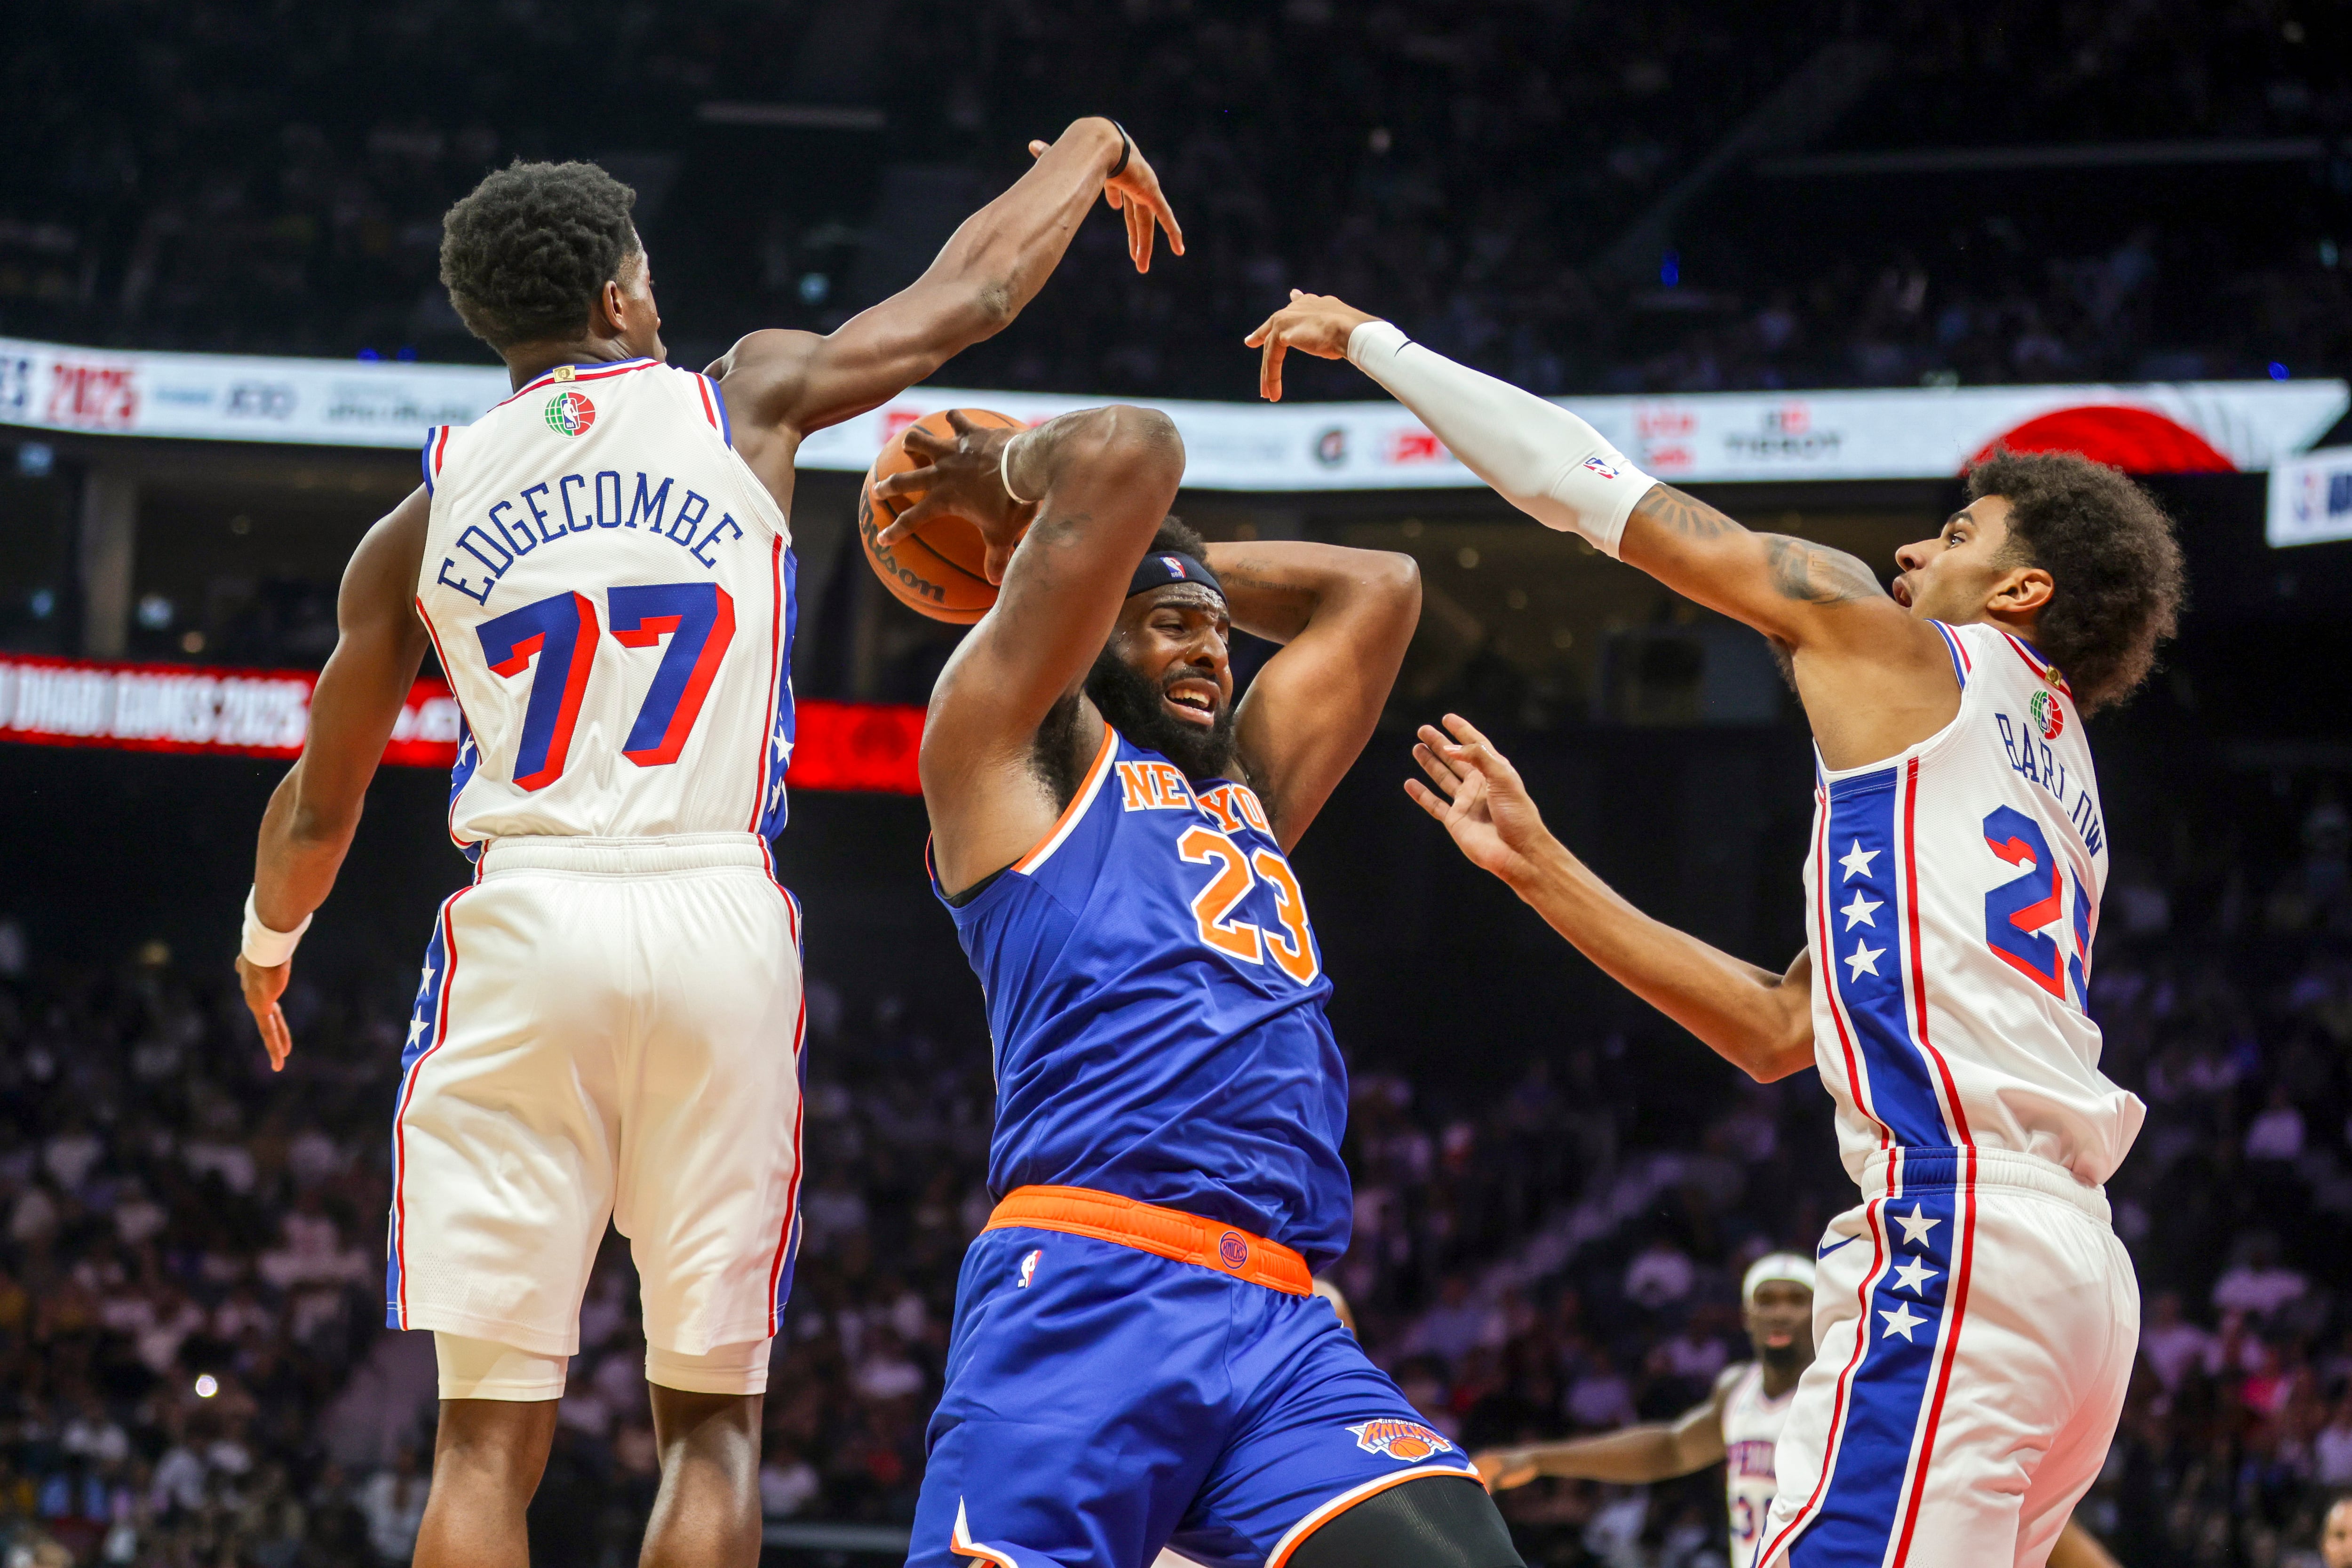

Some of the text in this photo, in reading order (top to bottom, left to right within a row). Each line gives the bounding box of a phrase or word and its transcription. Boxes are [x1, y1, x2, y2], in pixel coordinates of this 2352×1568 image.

[438, 471, 743, 606] EDGECOMBE
[475, 582, 736, 792] 77
[1114, 760, 1209, 819] NE
[1176, 825, 1319, 987] 23
[1223, 1241, 1244, 1259] KNICKS
[1361, 1422, 1449, 1447] KNICKS
